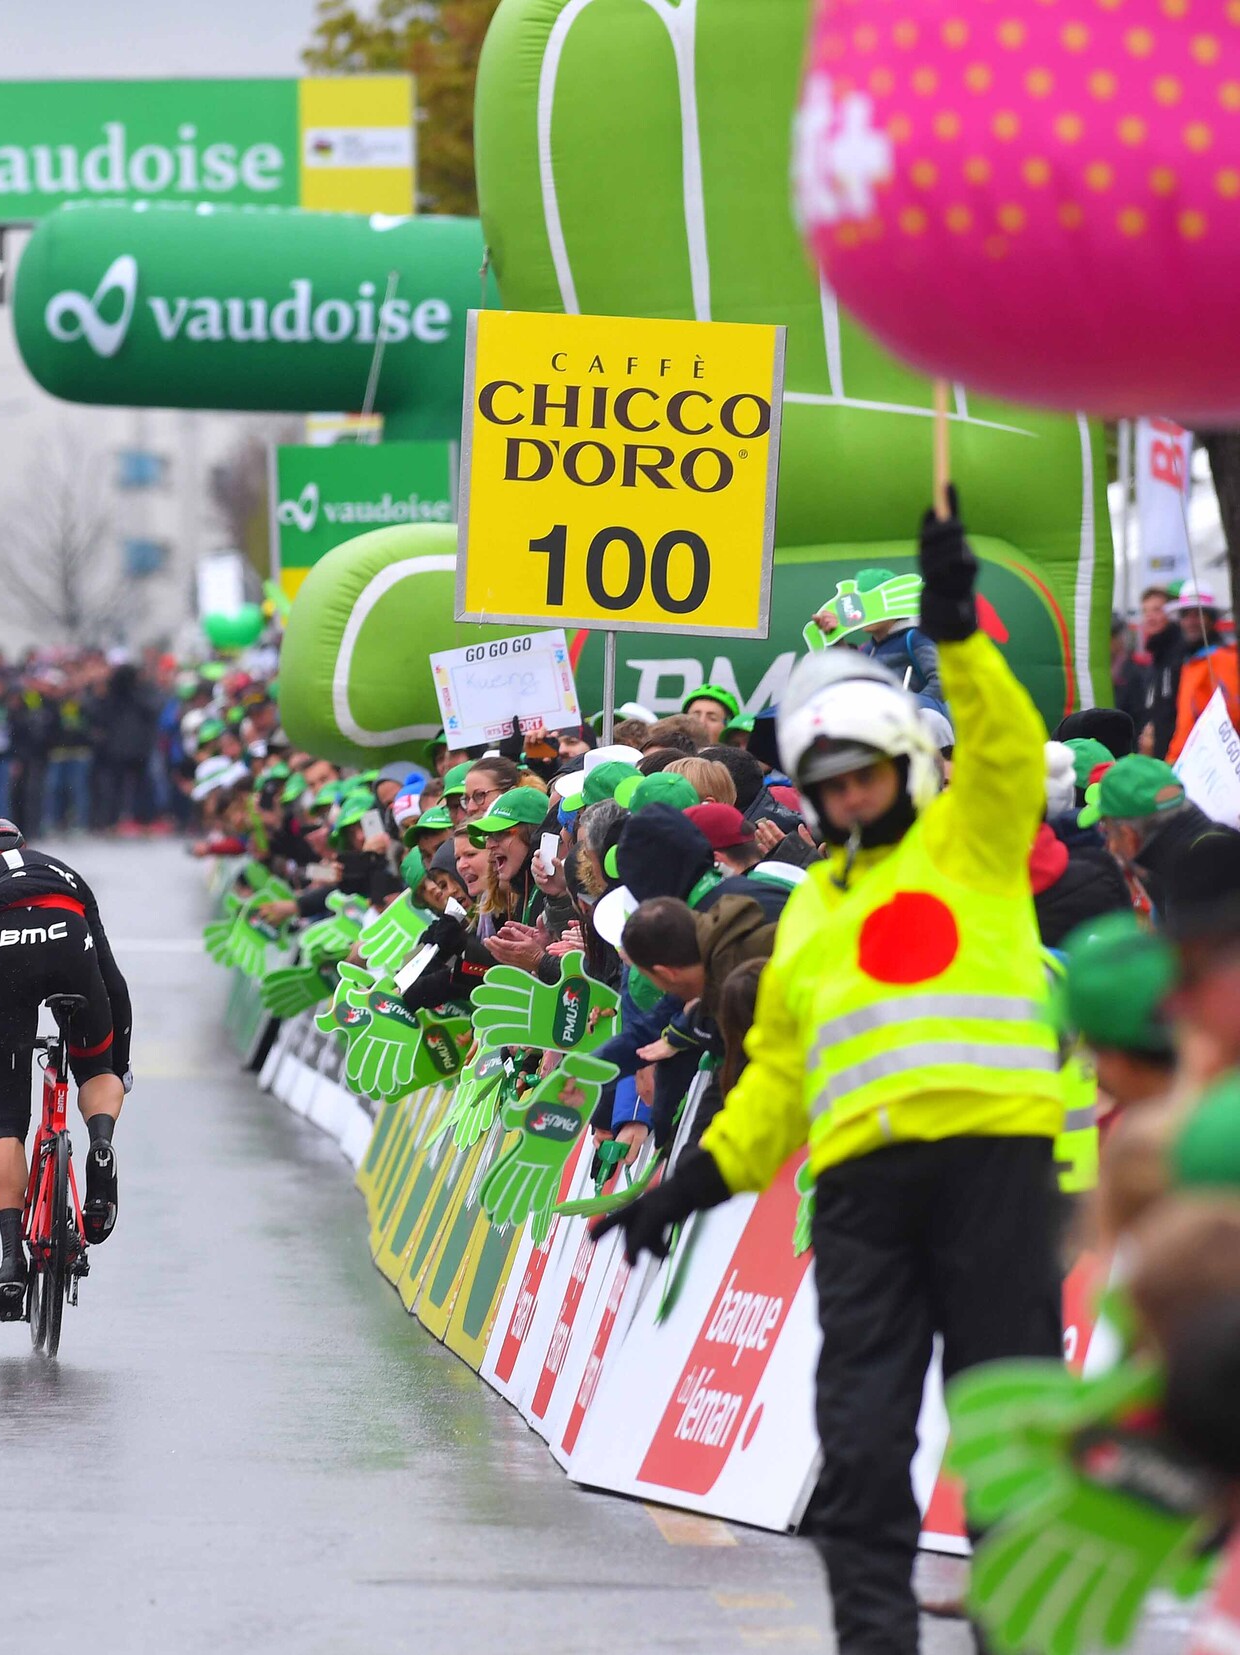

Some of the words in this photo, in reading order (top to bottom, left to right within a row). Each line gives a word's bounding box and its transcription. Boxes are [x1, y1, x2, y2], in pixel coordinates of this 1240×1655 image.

[148, 278, 452, 344] vaudoise
[551, 352, 705, 379] CAFFÈ
[478, 380, 771, 439] CHICCO
[503, 437, 734, 493] D'ORO
[323, 493, 452, 523] vaudoise
[528, 524, 711, 615] 100
[465, 646, 485, 663] GO
[489, 641, 508, 658] GO
[512, 637, 532, 654] GO
[626, 650, 798, 714] PM
[502, 716, 542, 737] SORT
[0, 921, 69, 947] BMC
[56, 1089, 65, 1113] BMC
[705, 1268, 784, 1368] banque
[674, 1366, 743, 1449] léman
